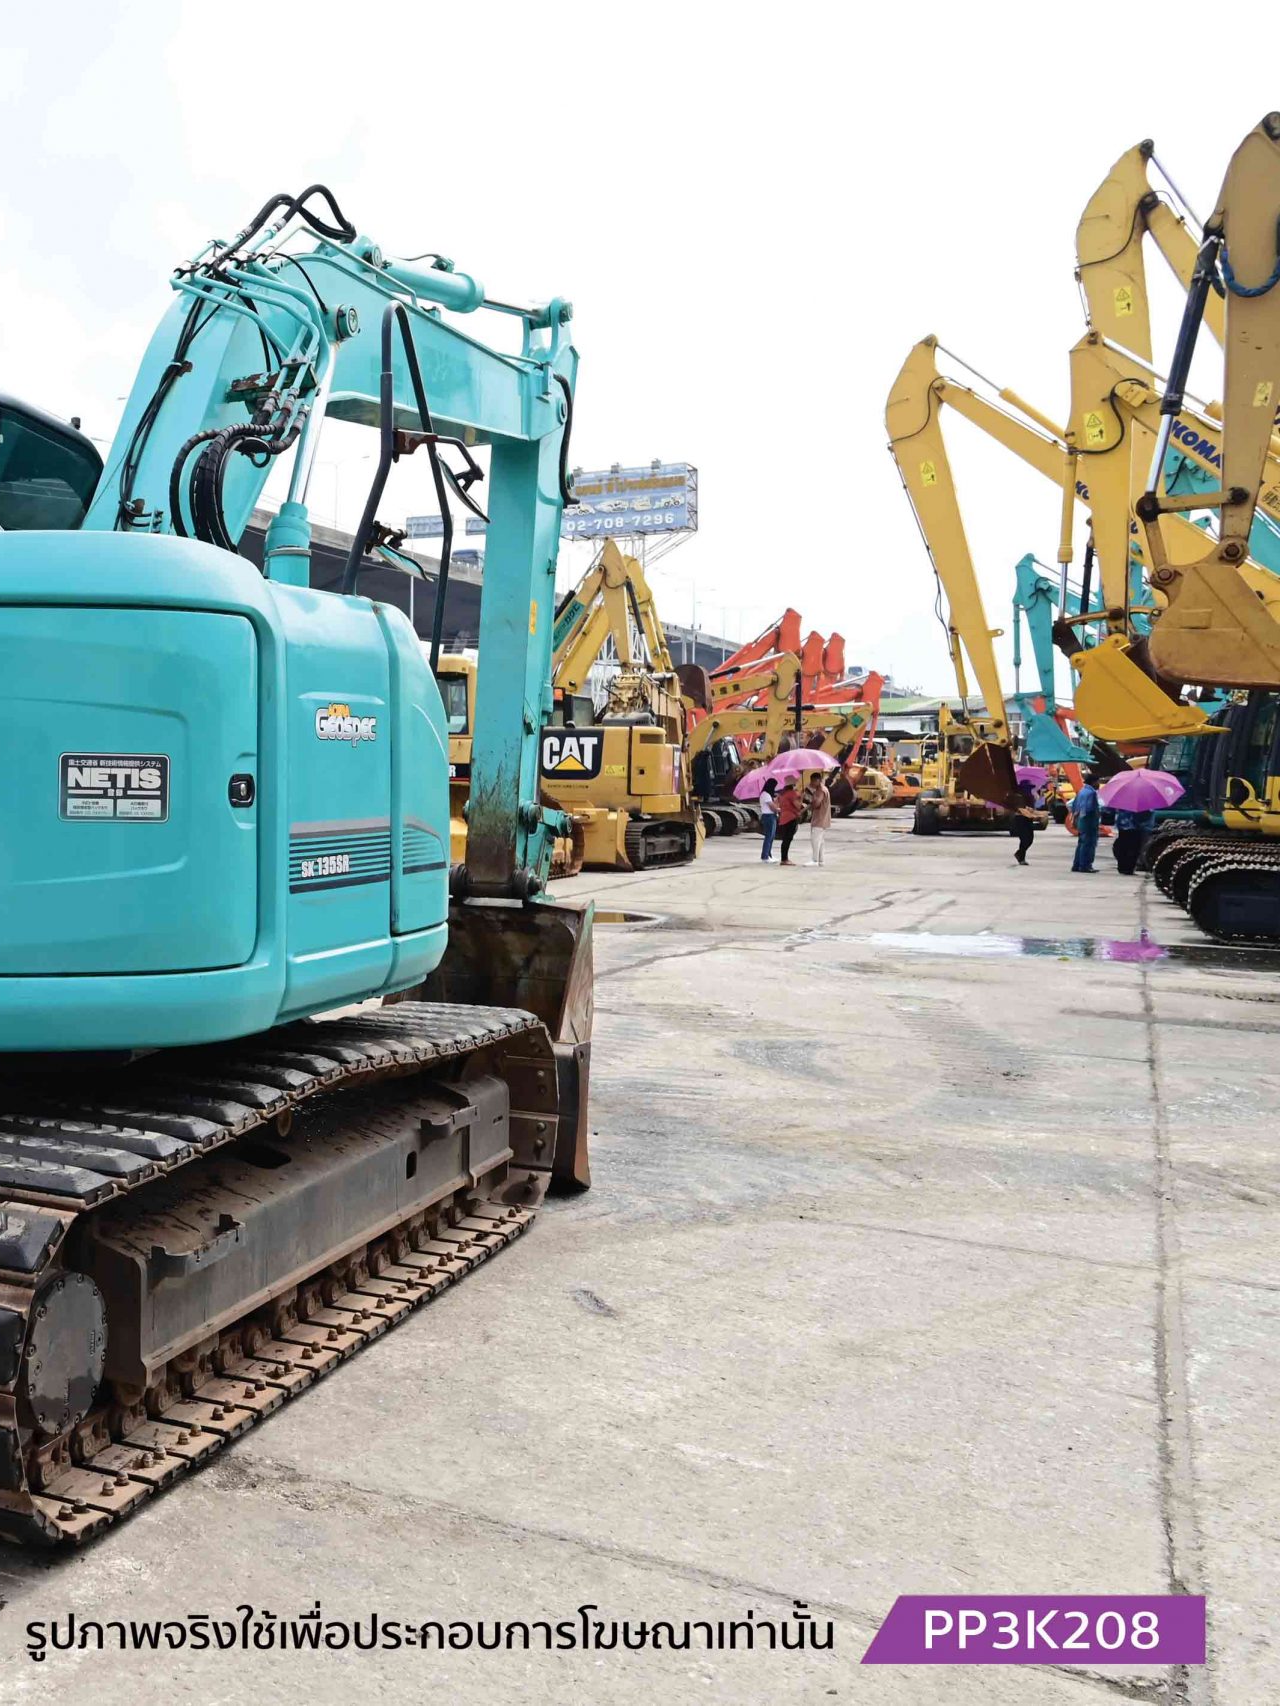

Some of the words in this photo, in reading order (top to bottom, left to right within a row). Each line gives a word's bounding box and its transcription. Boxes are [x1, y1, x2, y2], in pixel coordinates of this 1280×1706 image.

[566, 513, 675, 532] 02-708-7296
[315, 707, 377, 747] Geospec
[542, 736, 598, 771] CAT
[67, 767, 162, 789] NETIS
